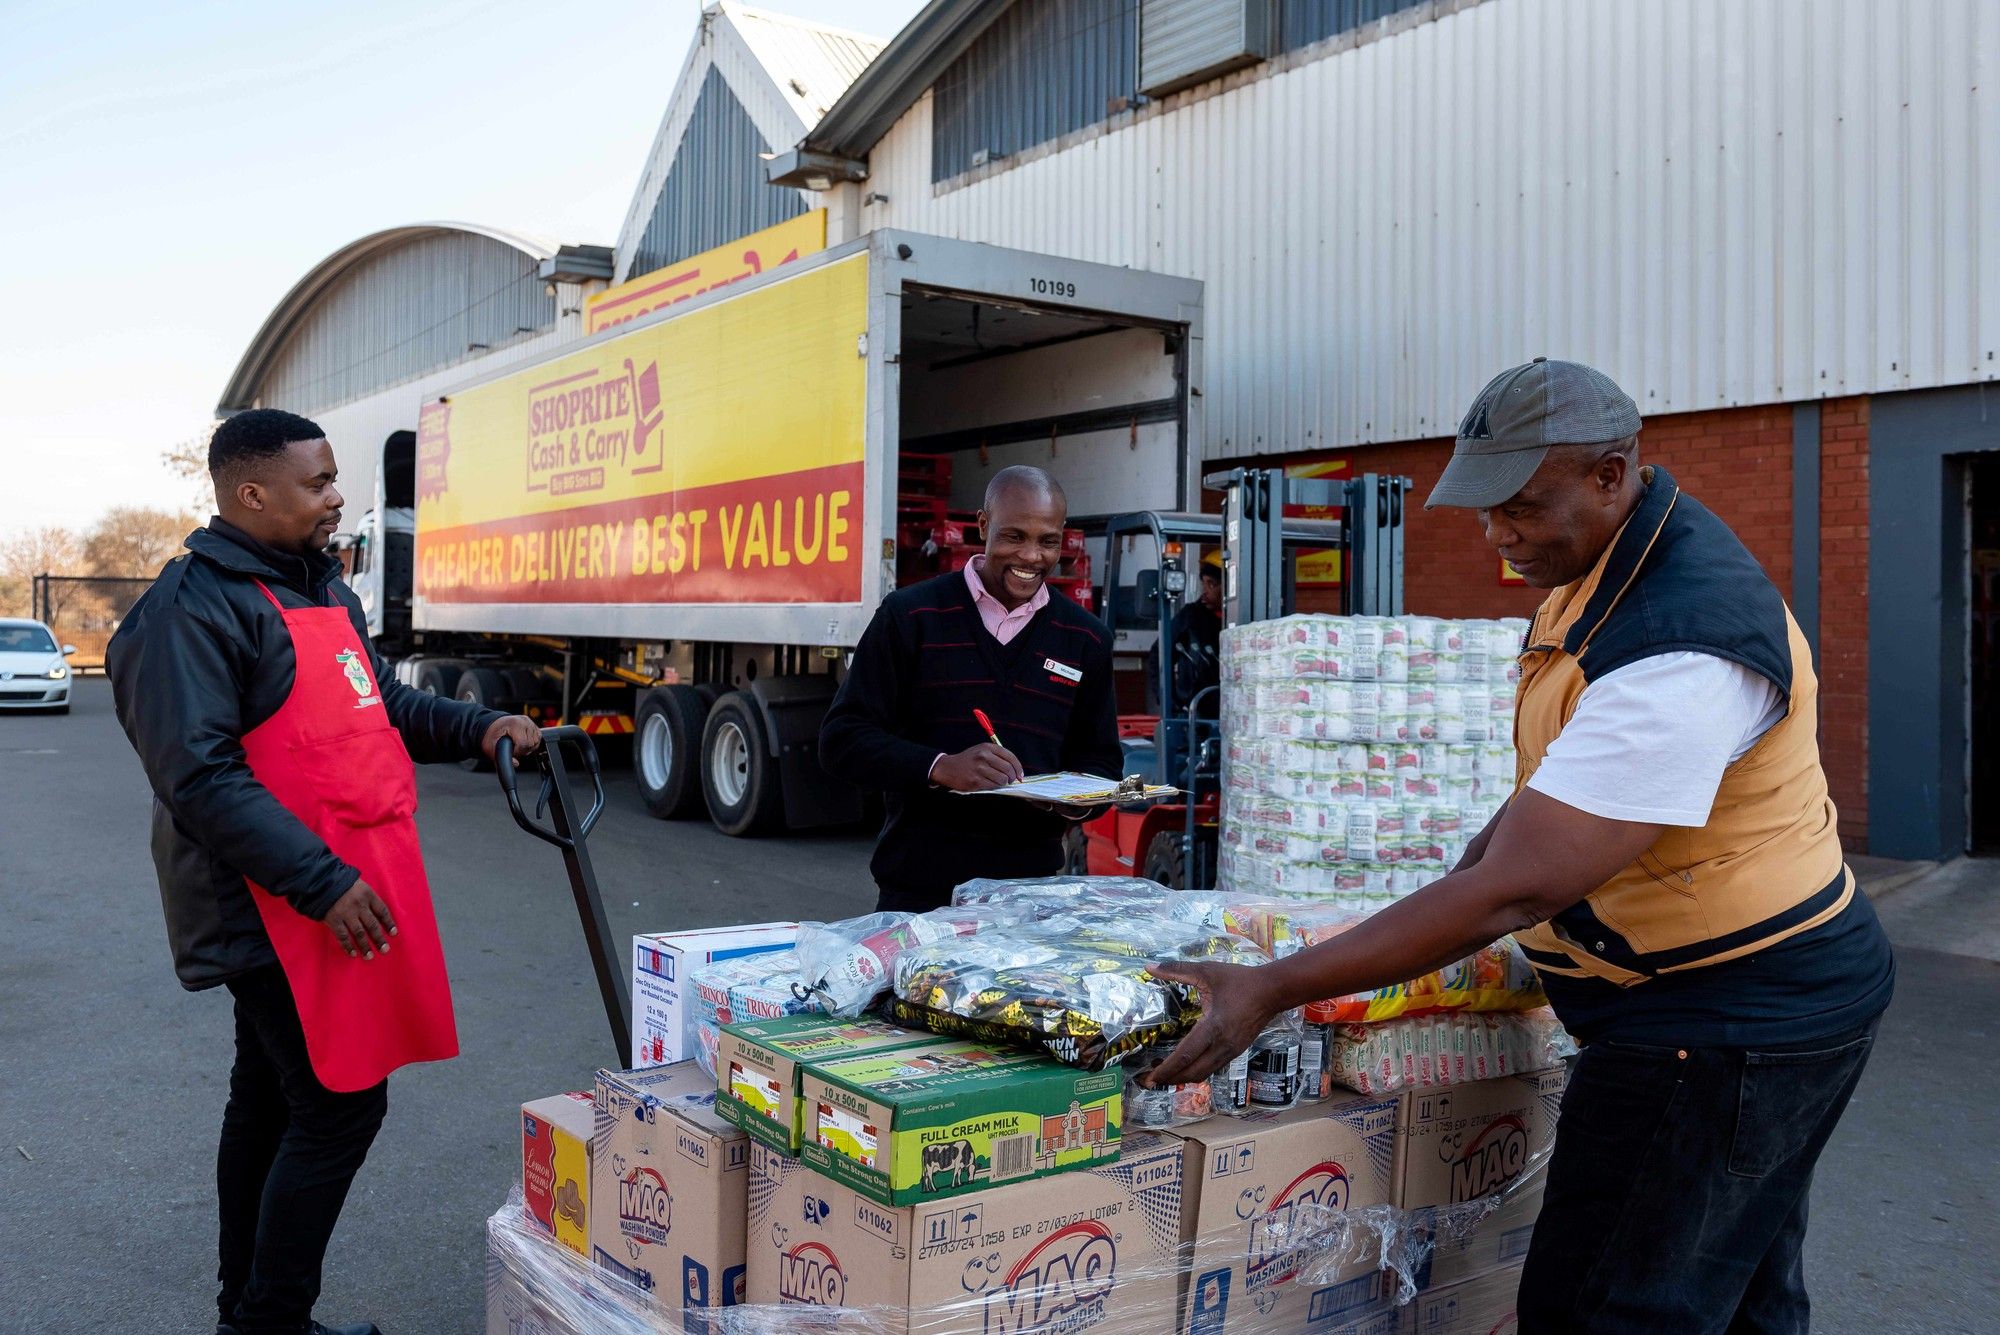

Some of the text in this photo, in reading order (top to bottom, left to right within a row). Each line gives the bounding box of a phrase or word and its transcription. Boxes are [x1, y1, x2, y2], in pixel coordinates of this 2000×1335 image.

[1030, 278, 1075, 297] 10199
[531, 376, 629, 436] SHOPRITE
[531, 428, 629, 472] Cash & Carry
[422, 490, 850, 589] CHEAPER DELIVERY BEST VALUE
[847, 953, 859, 978] ROSES
[699, 984, 729, 1007] TRINCO
[746, 997, 782, 1019] TRINCO
[738, 1042, 745, 1053] 10
[752, 1047, 764, 1062] 500
[765, 1053, 774, 1066] ml
[1403, 1054, 1414, 1076] Selati
[1438, 1053, 1449, 1076] Selati
[927, 1076, 960, 1086] FULL
[961, 1069, 1008, 1081] CREAM
[1010, 1063, 1042, 1072] MILK
[1383, 1057, 1392, 1080] Selati
[824, 1086, 833, 1098] 10
[842, 1095, 856, 1108] 500
[857, 1102, 868, 1113] ml
[745, 1114, 755, 1124] The
[756, 1119, 775, 1138] Strong
[775, 1130, 786, 1143] One
[920, 1116, 1019, 1144] FULL CREAM MILK
[988, 1127, 1019, 1139] UHT PROCESS
[1366, 1113, 1391, 1131] 611062
[679, 1137, 705, 1159] 611062
[526, 1148, 550, 1177] Lemon
[837, 1159, 849, 1170] The
[850, 1164, 873, 1183] Strong
[873, 1175, 888, 1188] One
[1136, 1164, 1173, 1185] 611062
[1451, 1127, 1528, 1205] MAQ
[619, 1179, 671, 1233] MAQ
[619, 1220, 645, 1235] WASHING
[645, 1225, 667, 1241] POWDER
[858, 1206, 892, 1235] 611062
[918, 1239, 975, 1260] 27/03/24
[1012, 1223, 1032, 1239] EXP
[1037, 1213, 1085, 1233] 27/03/27
[1128, 1200, 1135, 1212] 2
[780, 1251, 845, 1306] MAQ
[984, 1235, 1116, 1335] MAQ
[1246, 1255, 1294, 1288] WASHING
[1050, 1300, 1104, 1335] POWDER
